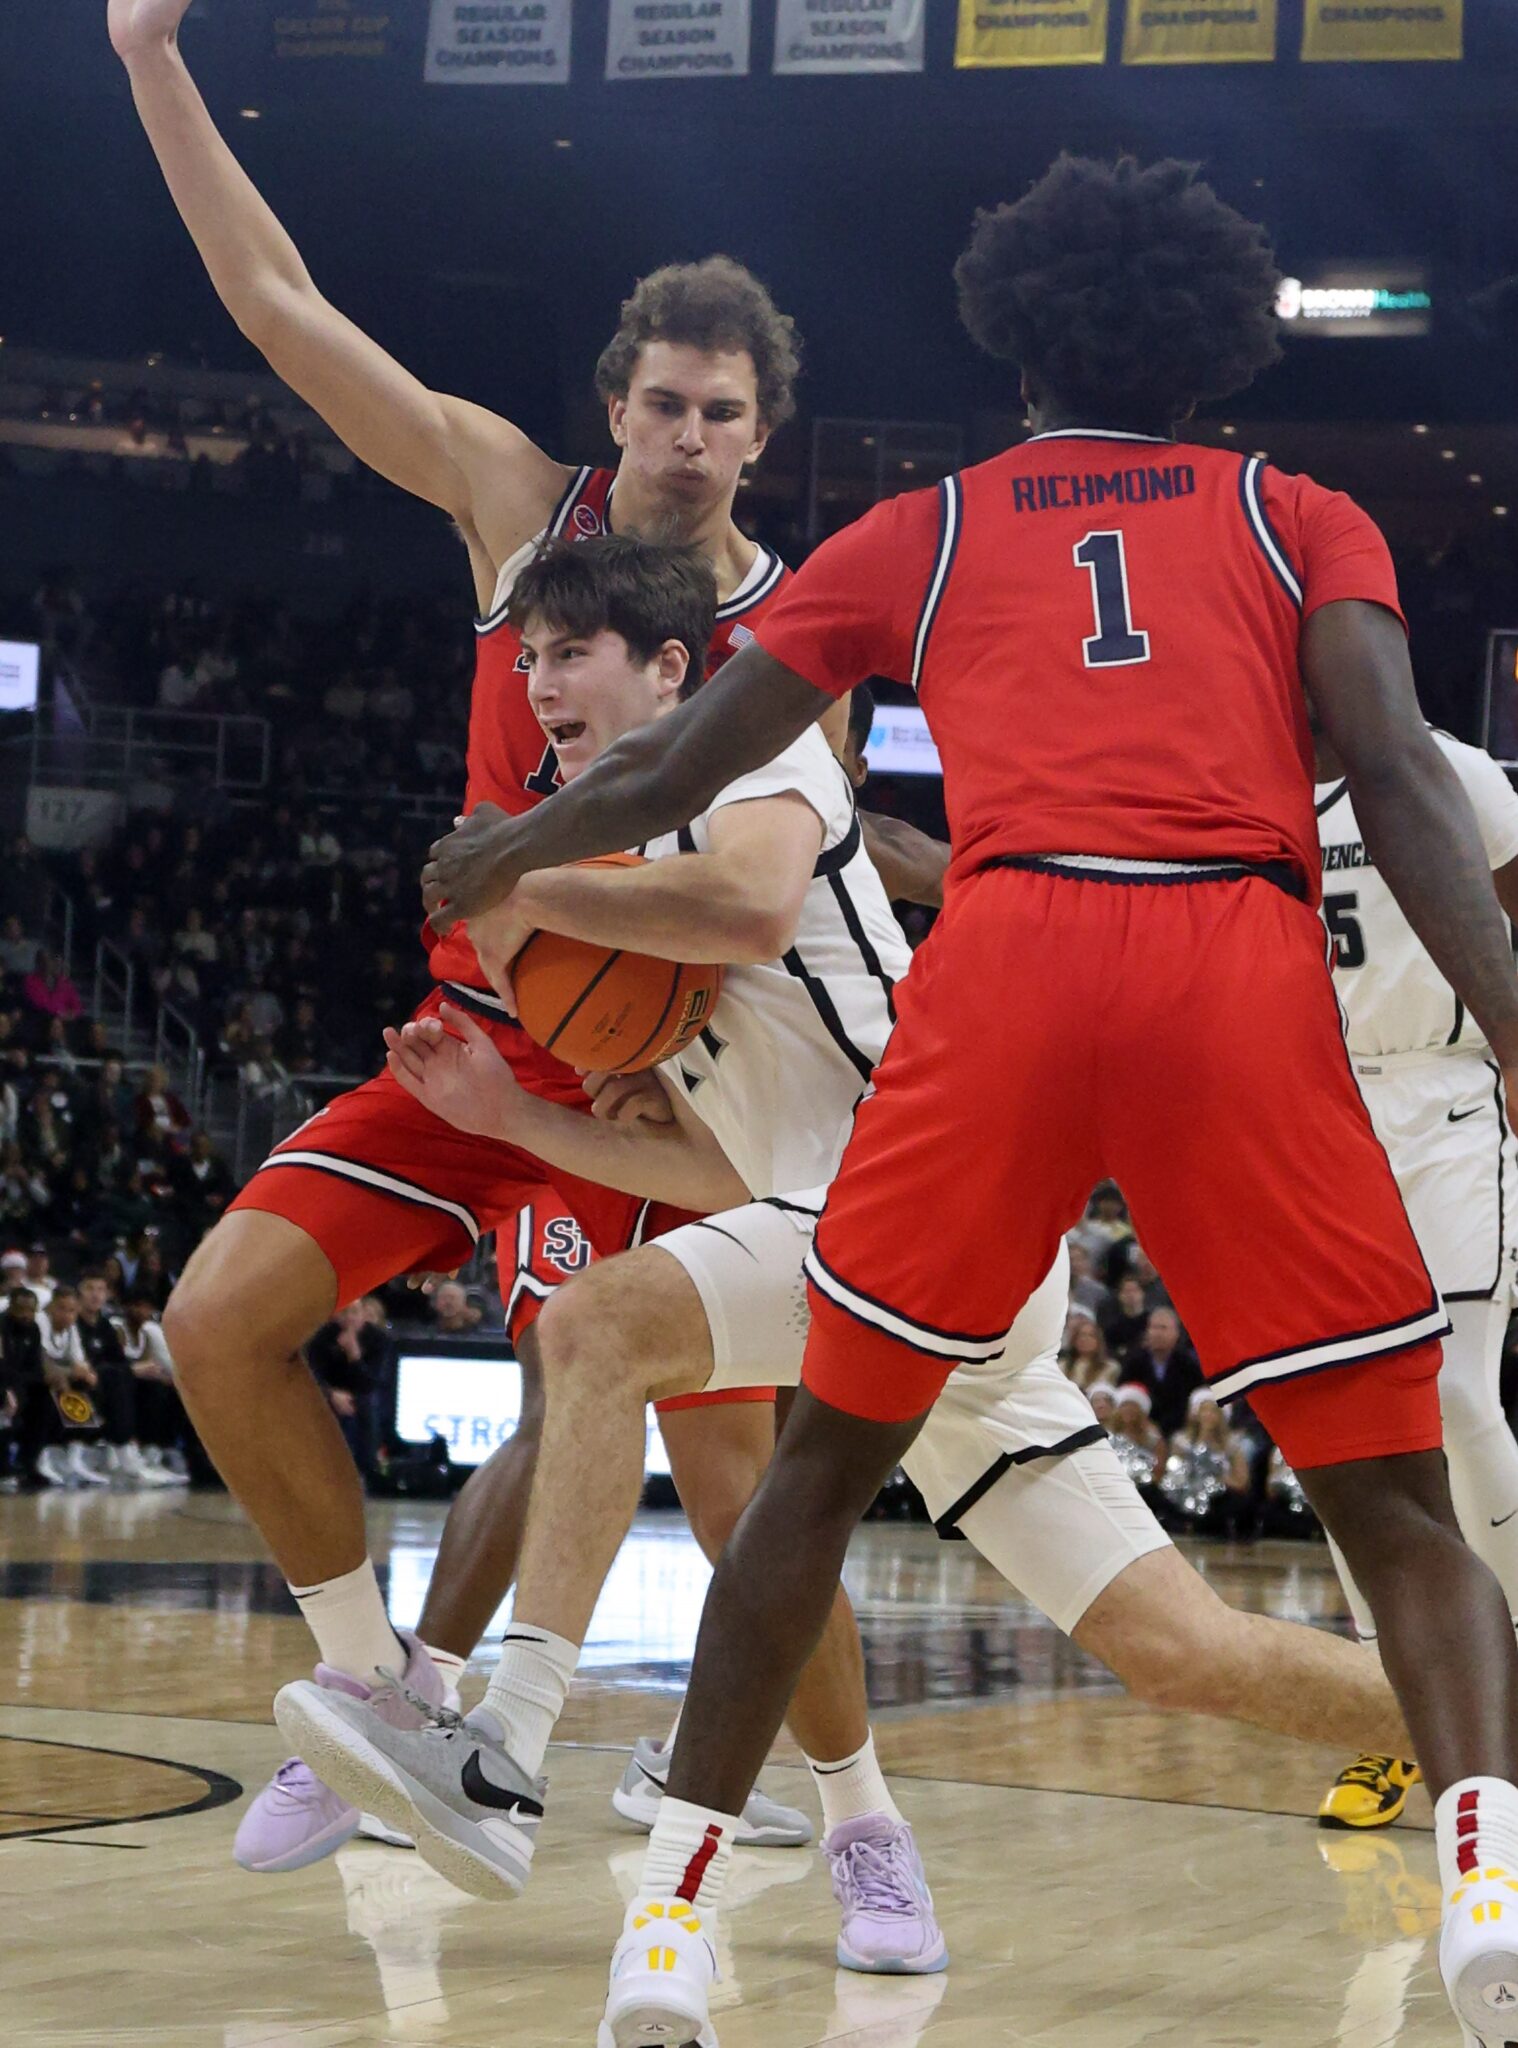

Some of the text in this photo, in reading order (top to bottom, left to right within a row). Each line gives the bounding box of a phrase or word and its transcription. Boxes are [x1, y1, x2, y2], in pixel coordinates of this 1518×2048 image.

[454, 2, 546, 22] REGULAR
[633, 2, 722, 20] REGULAR
[1139, 9, 1258, 28] CHAMPIONS
[1318, 5, 1446, 24] CHAMPIONS
[809, 20, 887, 37] SEASON
[974, 12, 1090, 30] CHAMPIONS
[457, 27, 542, 45] SEASON
[637, 29, 716, 46] SEASON
[434, 48, 557, 67] CHAMPIONS
[787, 41, 907, 61] CHAMPIONS
[617, 52, 734, 72] CHAMPIONS
[1011, 464, 1196, 513] RICHMOND
[1073, 529, 1151, 668] 1
[1323, 889, 1368, 969] 5
